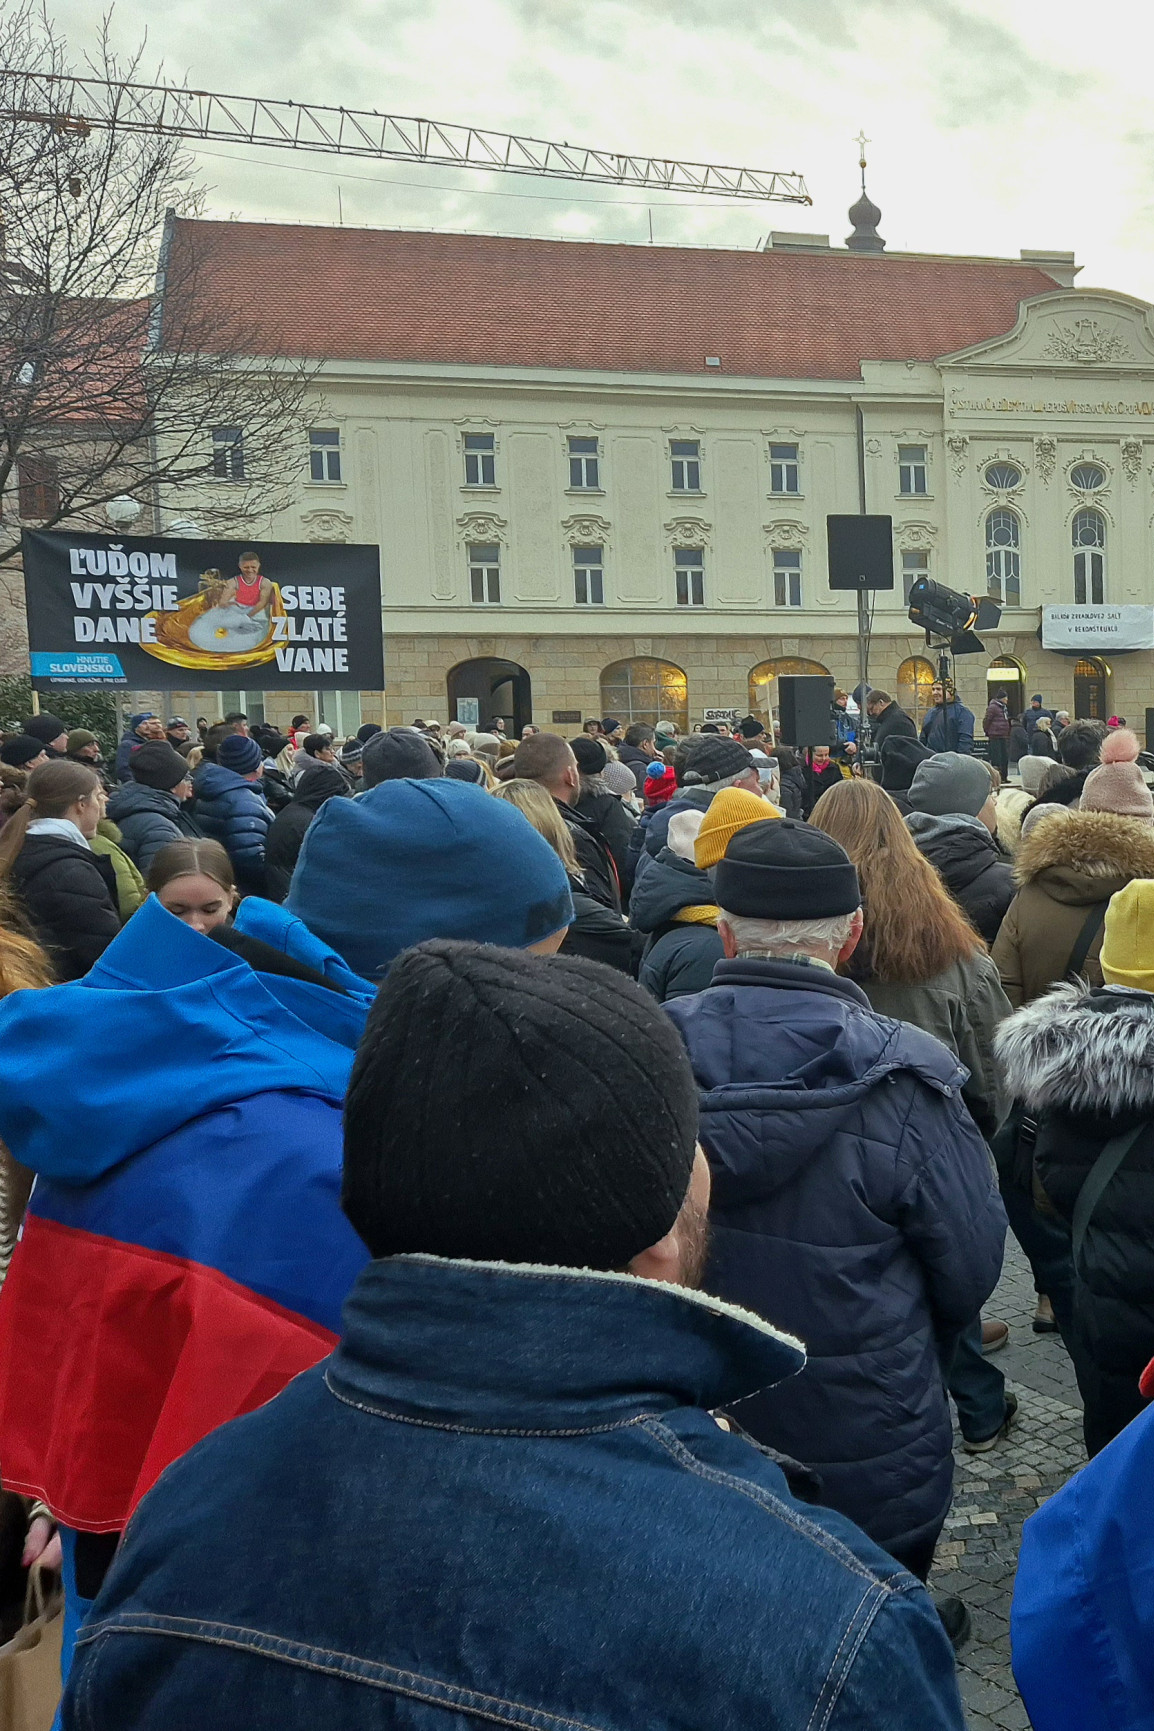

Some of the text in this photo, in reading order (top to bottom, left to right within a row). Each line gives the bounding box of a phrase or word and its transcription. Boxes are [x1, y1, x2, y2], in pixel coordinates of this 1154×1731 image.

[69, 543, 177, 578] ĽUĎOM
[70, 577, 180, 611] VYŠŠIE
[281, 585, 346, 610] SEBE
[74, 616, 158, 643] DANE
[272, 611, 348, 641] ZLATÉ
[49, 664, 114, 673] SLOVENSKO
[274, 648, 349, 672] VANE
